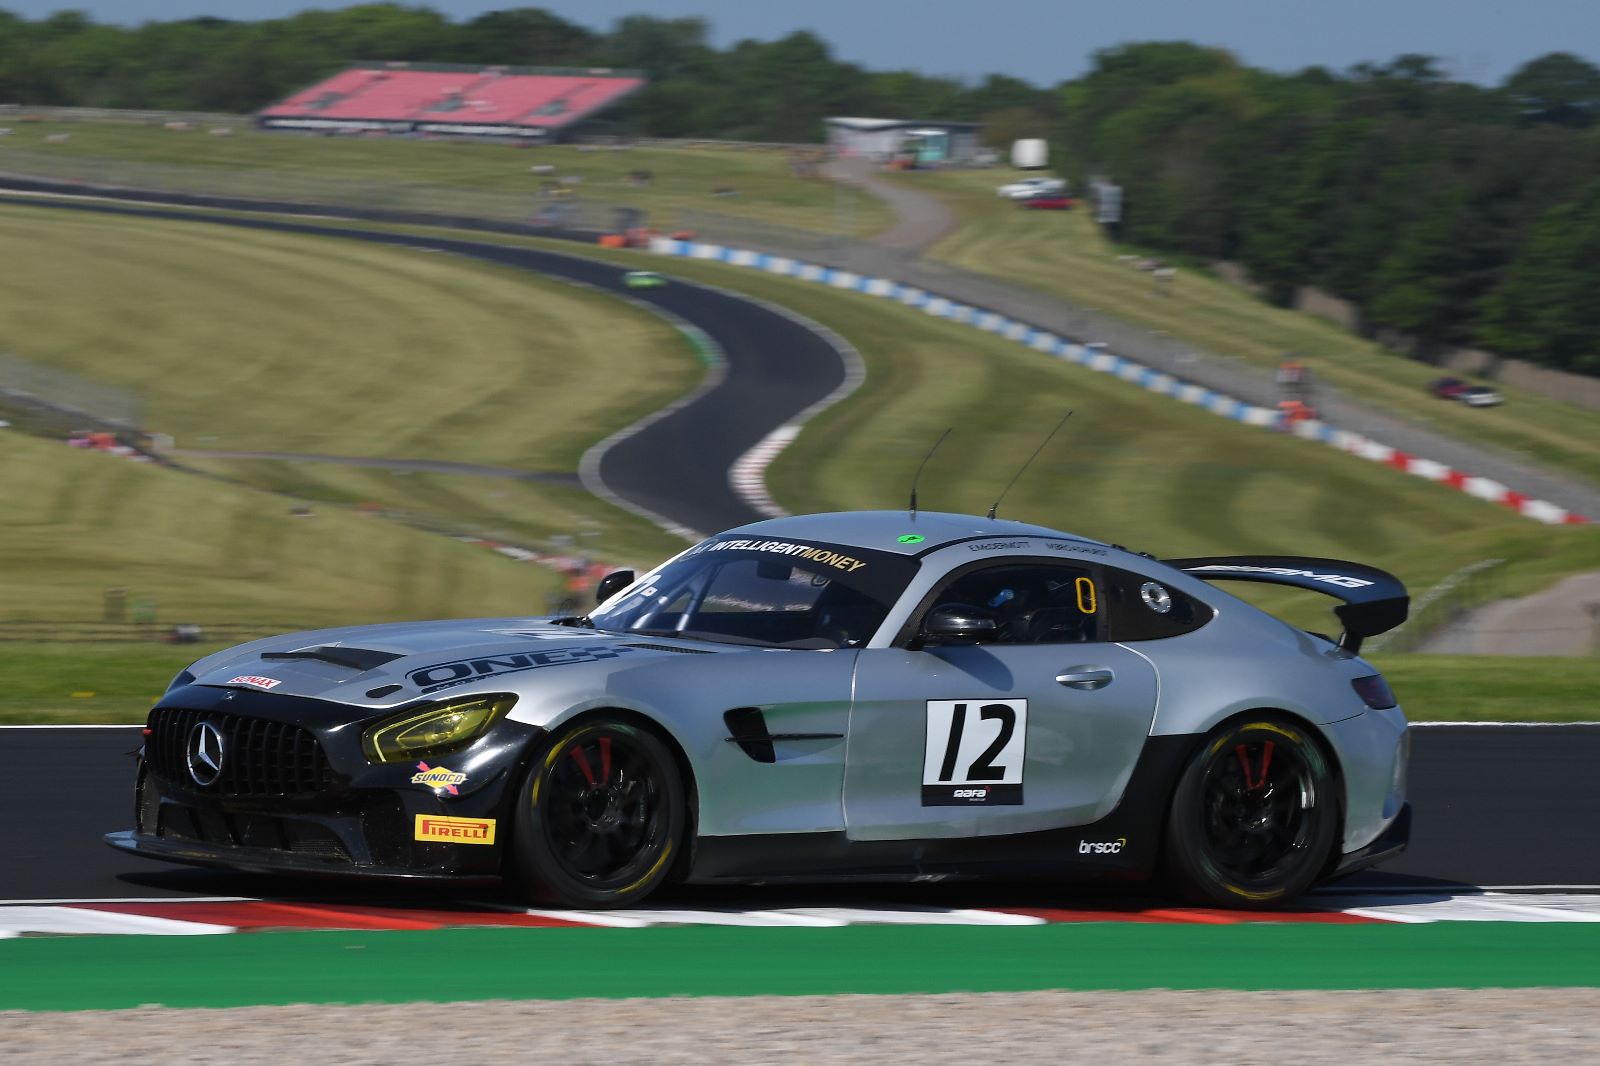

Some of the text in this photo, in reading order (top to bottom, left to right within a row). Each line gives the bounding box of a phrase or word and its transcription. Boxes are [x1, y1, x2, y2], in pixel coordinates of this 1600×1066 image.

[938, 703, 1017, 782] 12
[414, 773, 463, 783] SUNOCO
[422, 820, 489, 839] PIRELLI
[1079, 839, 1122, 854] brscc
